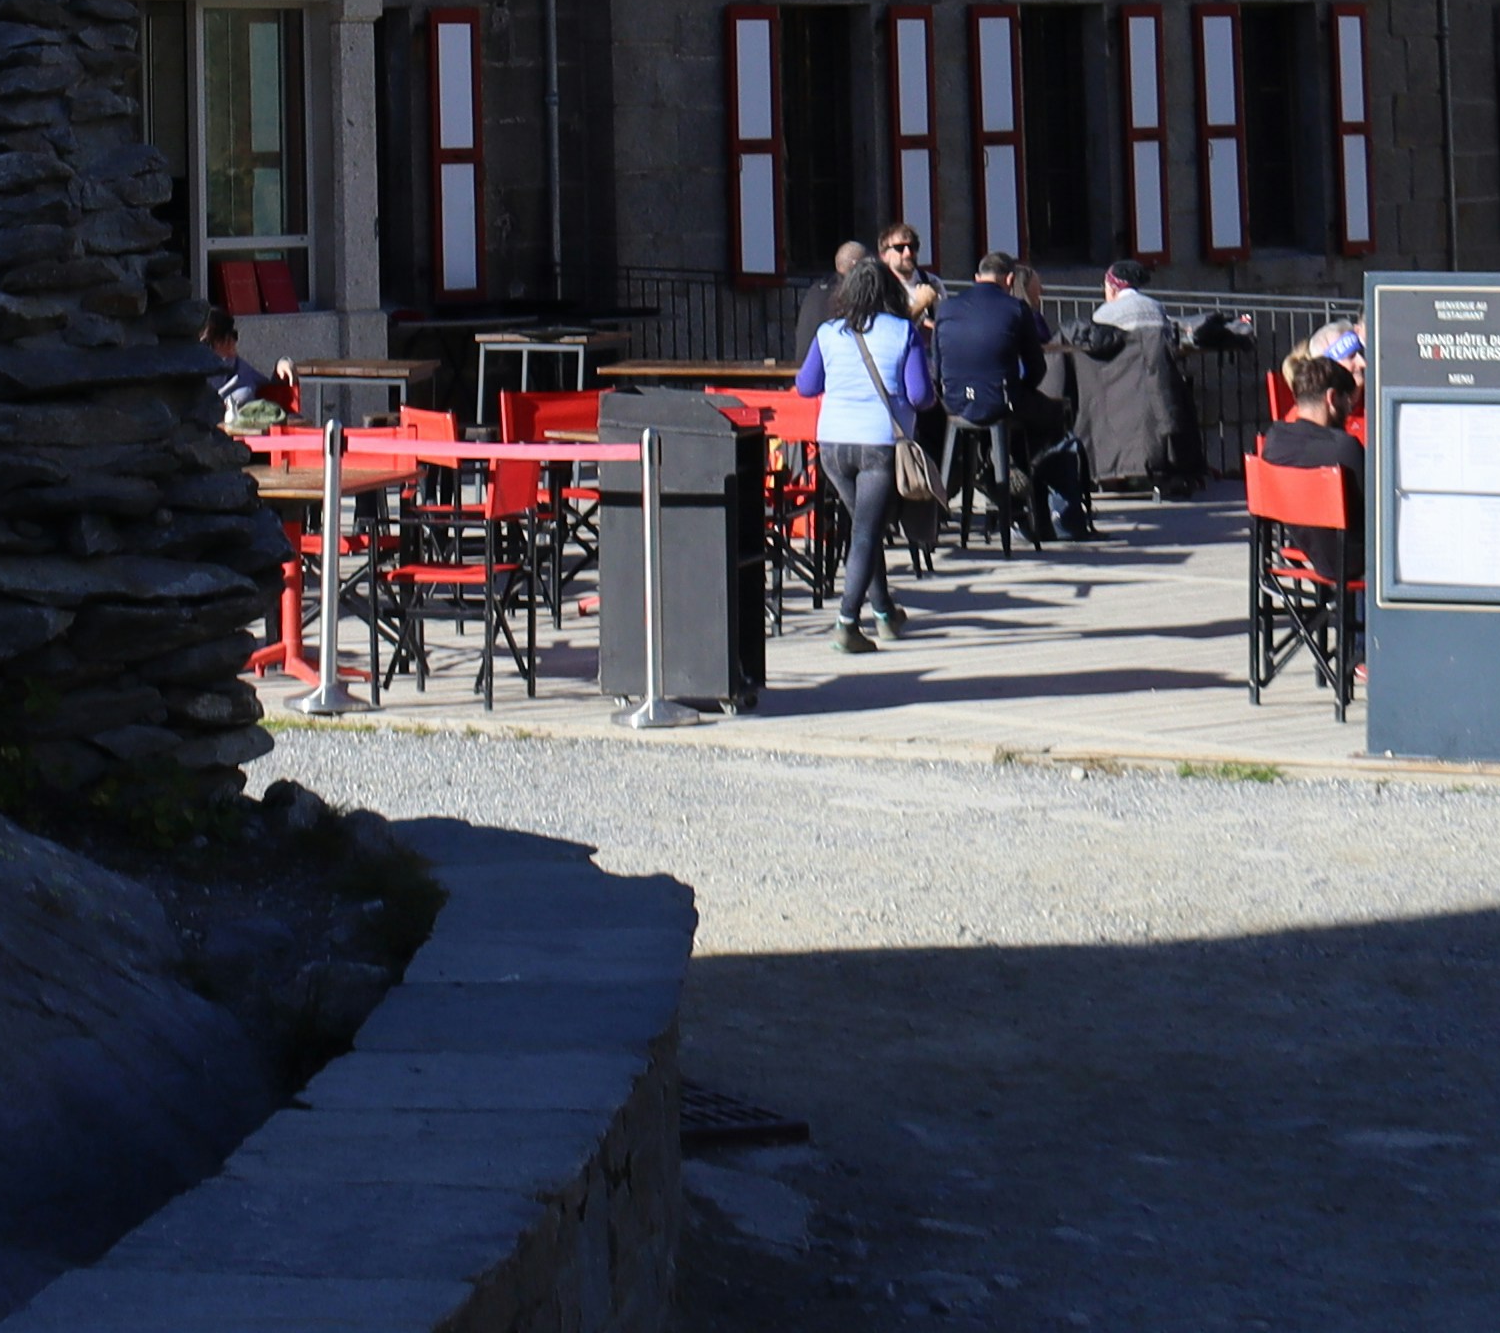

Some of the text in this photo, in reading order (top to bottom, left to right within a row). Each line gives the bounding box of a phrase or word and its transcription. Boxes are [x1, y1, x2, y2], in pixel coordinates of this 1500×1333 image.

[1434, 300, 1488, 312] BIENVENUE AU
[1437, 311, 1485, 321] RESTAURANT
[1416, 333, 1454, 346] GRAND
[1455, 331, 1487, 347] HÔTEL
[1448, 373, 1475, 385] MENU
